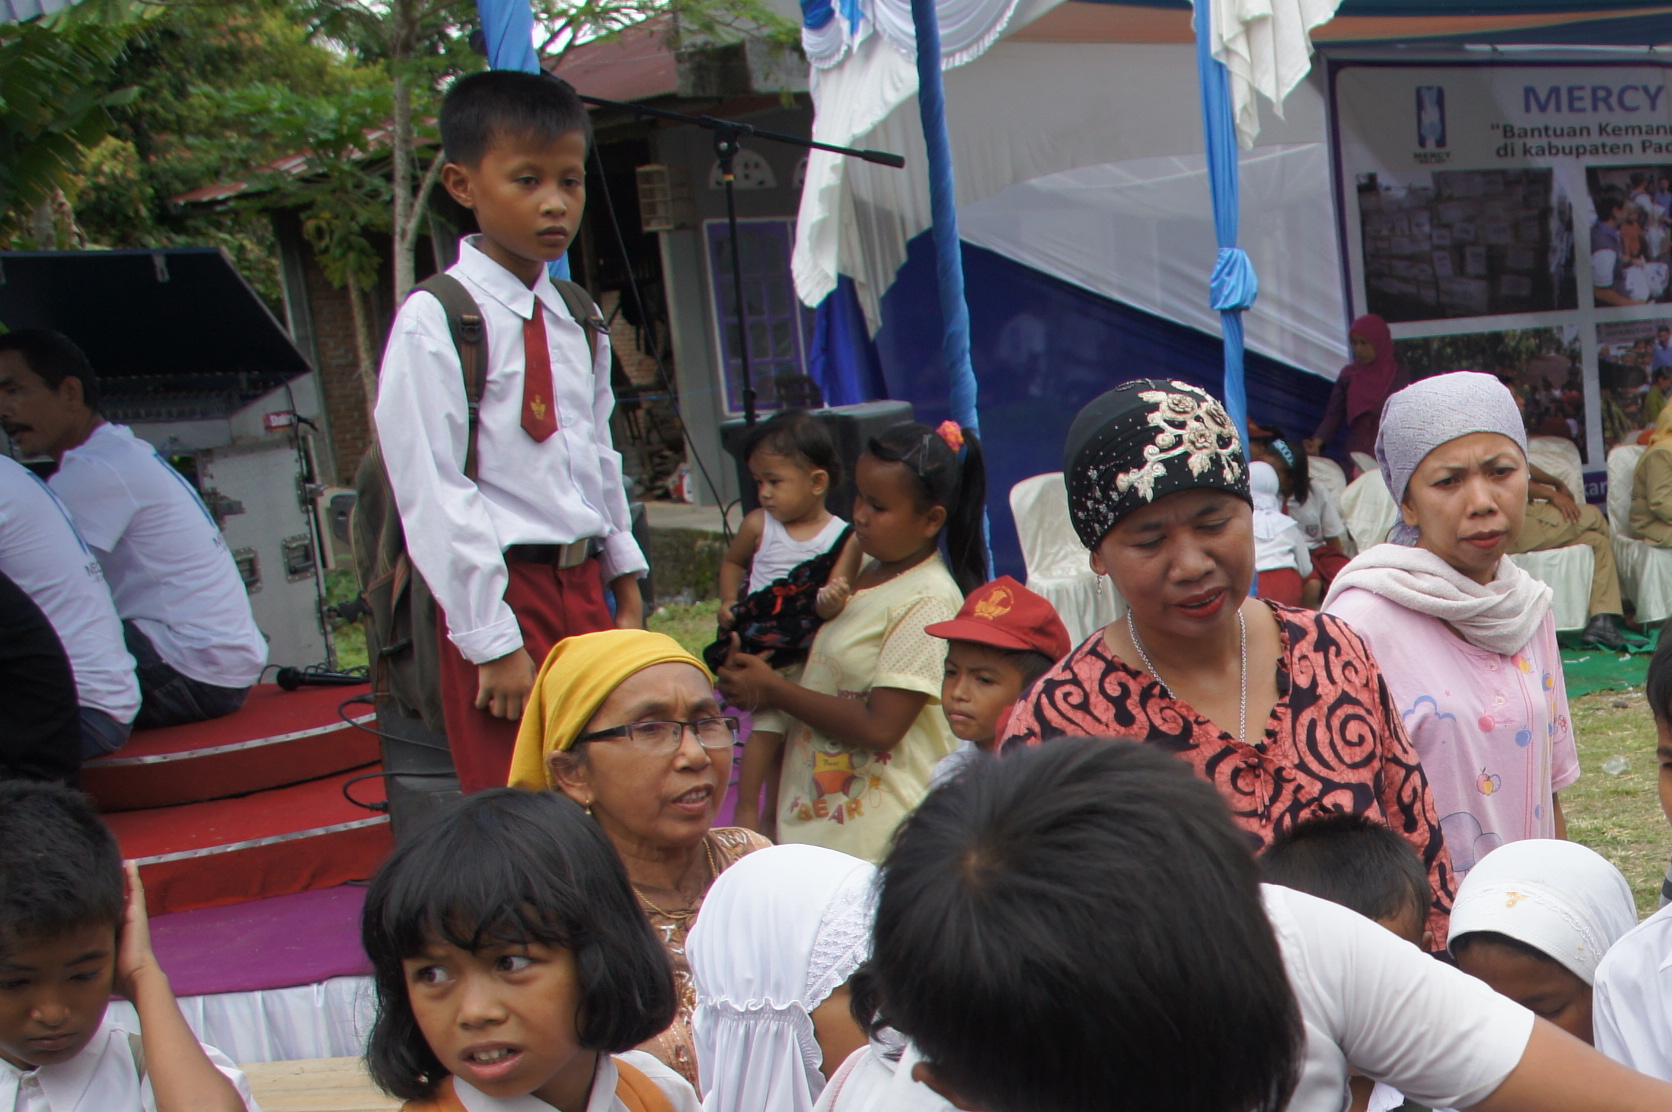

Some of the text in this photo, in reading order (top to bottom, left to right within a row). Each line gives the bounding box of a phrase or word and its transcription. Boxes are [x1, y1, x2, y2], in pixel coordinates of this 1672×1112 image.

[1523, 85, 1665, 113] MERCY
[1495, 142, 1515, 157] di
[1523, 141, 1634, 159] kabupaten
[797, 798, 864, 824] BEAR
